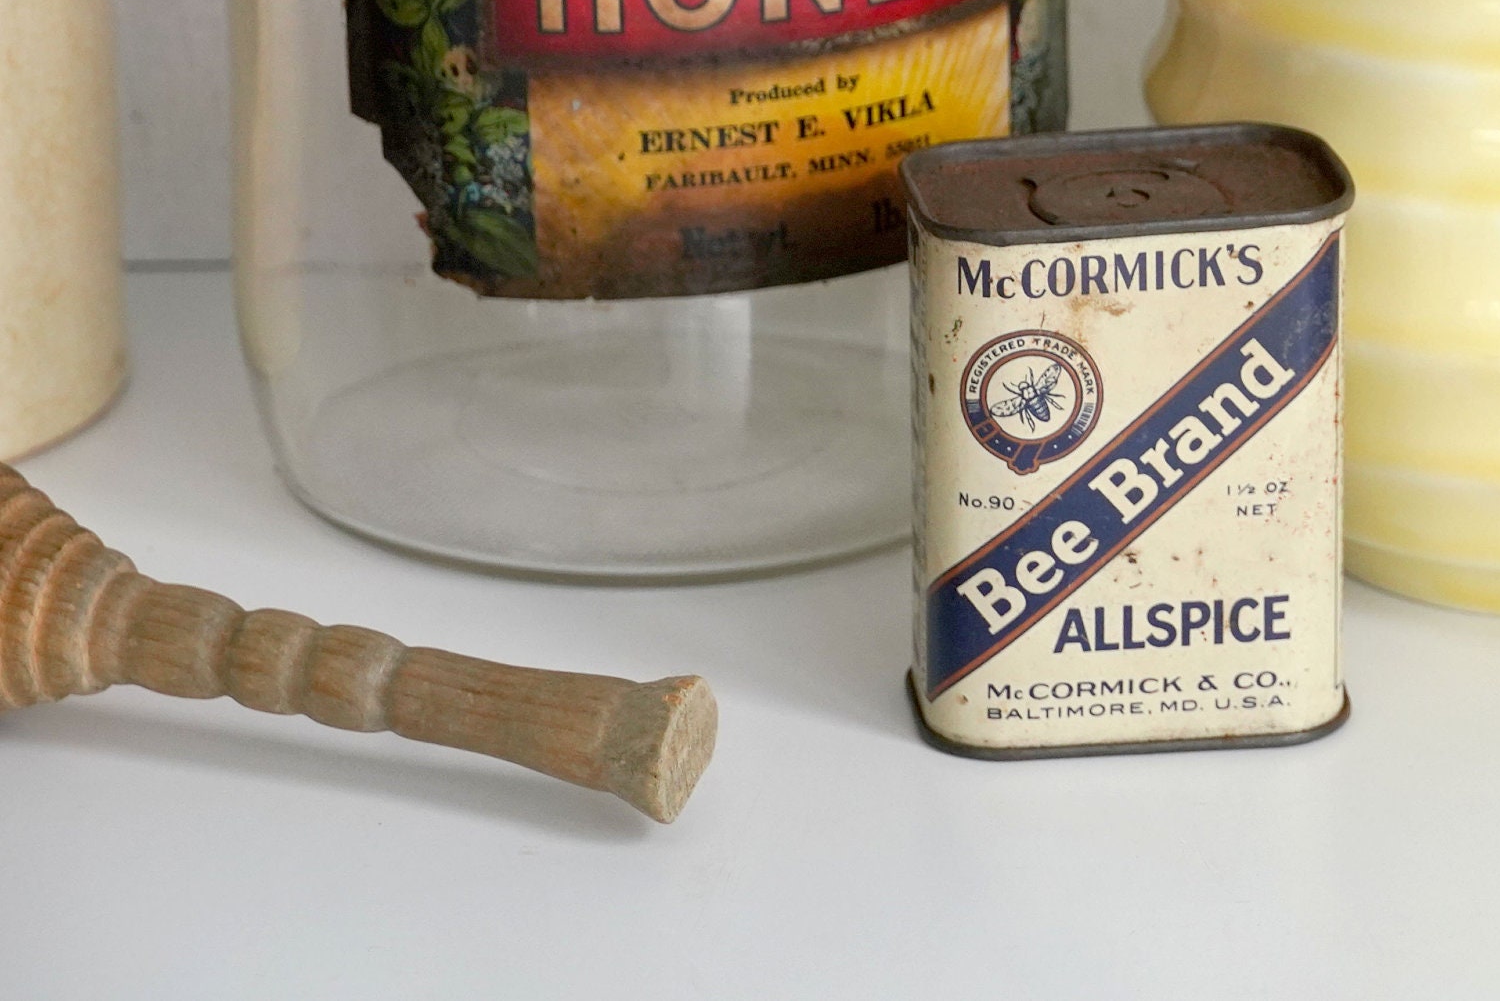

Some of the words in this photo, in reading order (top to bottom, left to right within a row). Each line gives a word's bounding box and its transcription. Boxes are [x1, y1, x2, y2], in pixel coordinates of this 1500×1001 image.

[729, 76, 826, 104] Produced
[836, 73, 861, 93] by
[639, 121, 779, 153] ERNEST
[796, 114, 826, 140] E.
[841, 88, 936, 131] VIKLA
[957, 243, 1265, 299] McCORMICK'S
[968, 337, 1026, 395] REGISTERED
[1031, 337, 1078, 361] TRADE
[1076, 360, 1095, 396] MARK
[956, 519, 1099, 636] Bee
[1088, 337, 1296, 526] Brand
[1236, 502, 1277, 517] NET
[1053, 595, 1291, 654] ALLSPICE
[986, 676, 1183, 700] McCORMICK
[1197, 675, 1218, 691] &
[1160, 699, 1204, 712] MD.
[1214, 694, 1292, 710] U.S.A.
